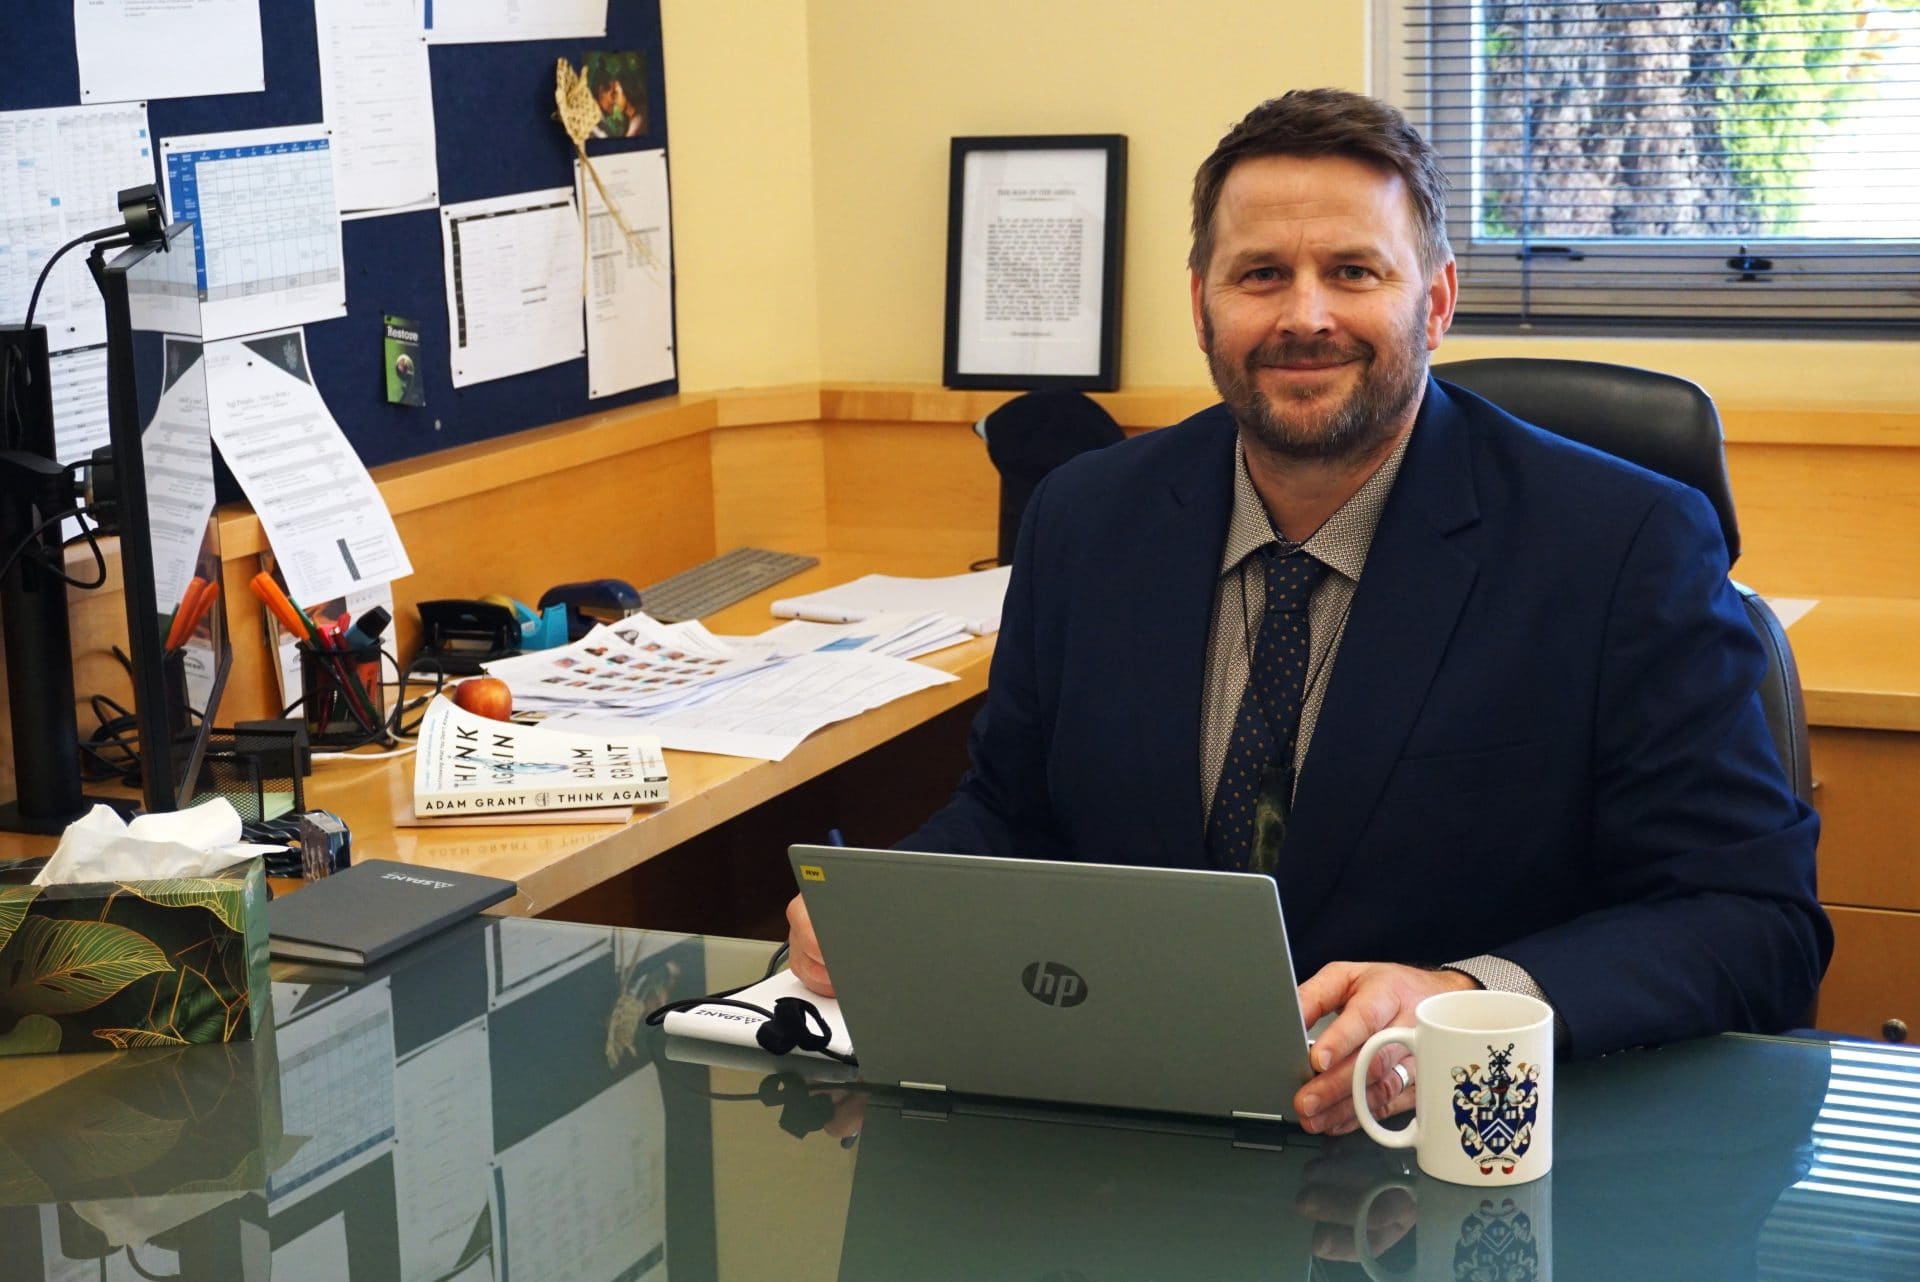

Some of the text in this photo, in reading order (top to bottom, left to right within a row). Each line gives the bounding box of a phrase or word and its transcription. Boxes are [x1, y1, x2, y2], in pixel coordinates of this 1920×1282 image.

[386, 325, 419, 341] Restore
[453, 725, 479, 788] THINK
[491, 733, 515, 785] AGAIN
[570, 748, 594, 779] ADAM
[607, 744, 634, 780] GRANT
[425, 788, 660, 810] ADAM GRANT THINK AGAIN
[1030, 960, 1082, 1008] hp
